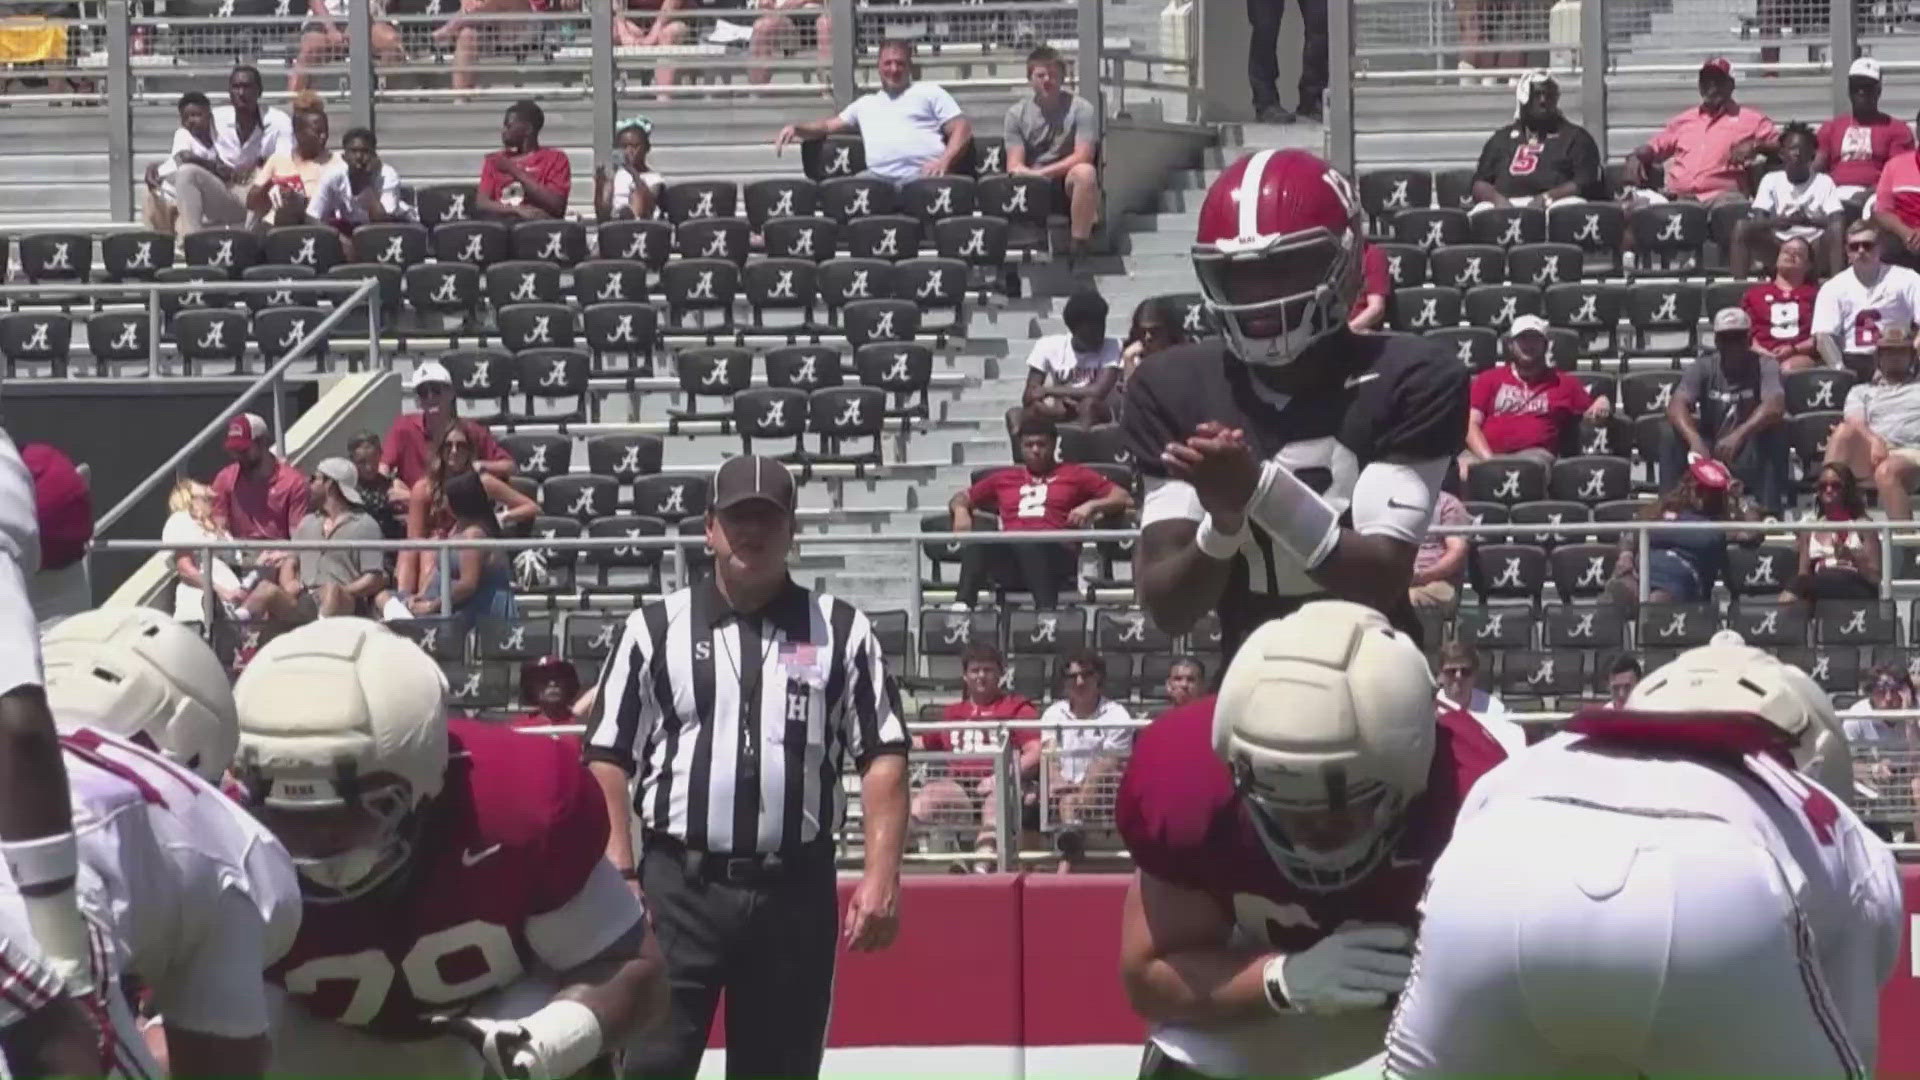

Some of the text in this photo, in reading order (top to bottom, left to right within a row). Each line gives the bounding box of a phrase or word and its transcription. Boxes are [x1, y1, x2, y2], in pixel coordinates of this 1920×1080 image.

[826, 147, 851, 173] A
[978, 147, 1001, 173] A
[1509, 142, 1545, 175] 5
[689, 191, 714, 219] A
[769, 190, 794, 216] A
[845, 189, 870, 214] A
[927, 187, 953, 213] A
[1002, 185, 1028, 212] A
[1384, 180, 1409, 207] A
[441, 194, 466, 220] A
[1419, 221, 1445, 248] A
[1497, 218, 1523, 244] A
[1574, 214, 1600, 239] A
[1657, 214, 1684, 240] A
[127, 242, 153, 268] A
[208, 240, 233, 267] A
[291, 238, 317, 264] A
[377, 236, 403, 262] A
[458, 234, 483, 260] A
[538, 232, 564, 258] A
[623, 232, 648, 258] A
[703, 230, 728, 256] A
[788, 229, 813, 255] A
[873, 229, 898, 255] A
[959, 229, 985, 255] A
[44, 243, 71, 269] A
[1388, 256, 1403, 282] A
[1456, 258, 1482, 284] A
[1533, 256, 1560, 283] A
[431, 275, 457, 301] A
[511, 273, 537, 300] A
[597, 272, 624, 299] A
[688, 271, 714, 298] A
[768, 271, 794, 297] A
[843, 271, 869, 297] A
[918, 270, 943, 297] A
[1412, 299, 1439, 326] A
[1491, 297, 1517, 324] A
[1570, 295, 1597, 322] A
[1652, 293, 1677, 322] A
[1770, 301, 1800, 339] 9
[22, 323, 49, 349] A
[111, 323, 138, 349] A
[198, 321, 224, 348] A
[279, 320, 305, 347] A
[524, 317, 551, 342] A
[608, 315, 634, 341] A
[868, 311, 894, 338] A
[1854, 308, 1882, 347] 6
[1457, 340, 1474, 367] A
[464, 361, 490, 387] A
[540, 360, 567, 386] A
[702, 359, 729, 385] A
[790, 356, 817, 383] A
[882, 354, 910, 380] A
[1647, 383, 1673, 410] A
[1808, 380, 1834, 406] A
[758, 401, 785, 427] A
[835, 398, 862, 425] A
[1583, 428, 1609, 454] A
[520, 444, 548, 472] A
[614, 446, 640, 472] A
[1494, 471, 1521, 497] A
[1579, 469, 1605, 496] A
[568, 487, 596, 514] A
[658, 485, 684, 512] A
[1017, 484, 1047, 518] 2
[1494, 558, 1522, 586] A
[1578, 557, 1605, 585] A
[1746, 556, 1775, 584] A
[945, 615, 971, 643] A
[1031, 614, 1057, 642] A
[1119, 614, 1145, 641] A
[1477, 613, 1504, 637] A
[1569, 613, 1595, 637] A
[1660, 613, 1687, 636] A
[1751, 610, 1778, 634] A
[1841, 610, 1866, 634] A
[420, 628, 438, 651] A
[500, 626, 526, 649] A
[589, 624, 614, 648] A
[695, 640, 711, 661] S
[1528, 660, 1554, 683] A
[1809, 657, 1829, 680] A
[455, 672, 482, 697] A
[787, 693, 808, 721] H
